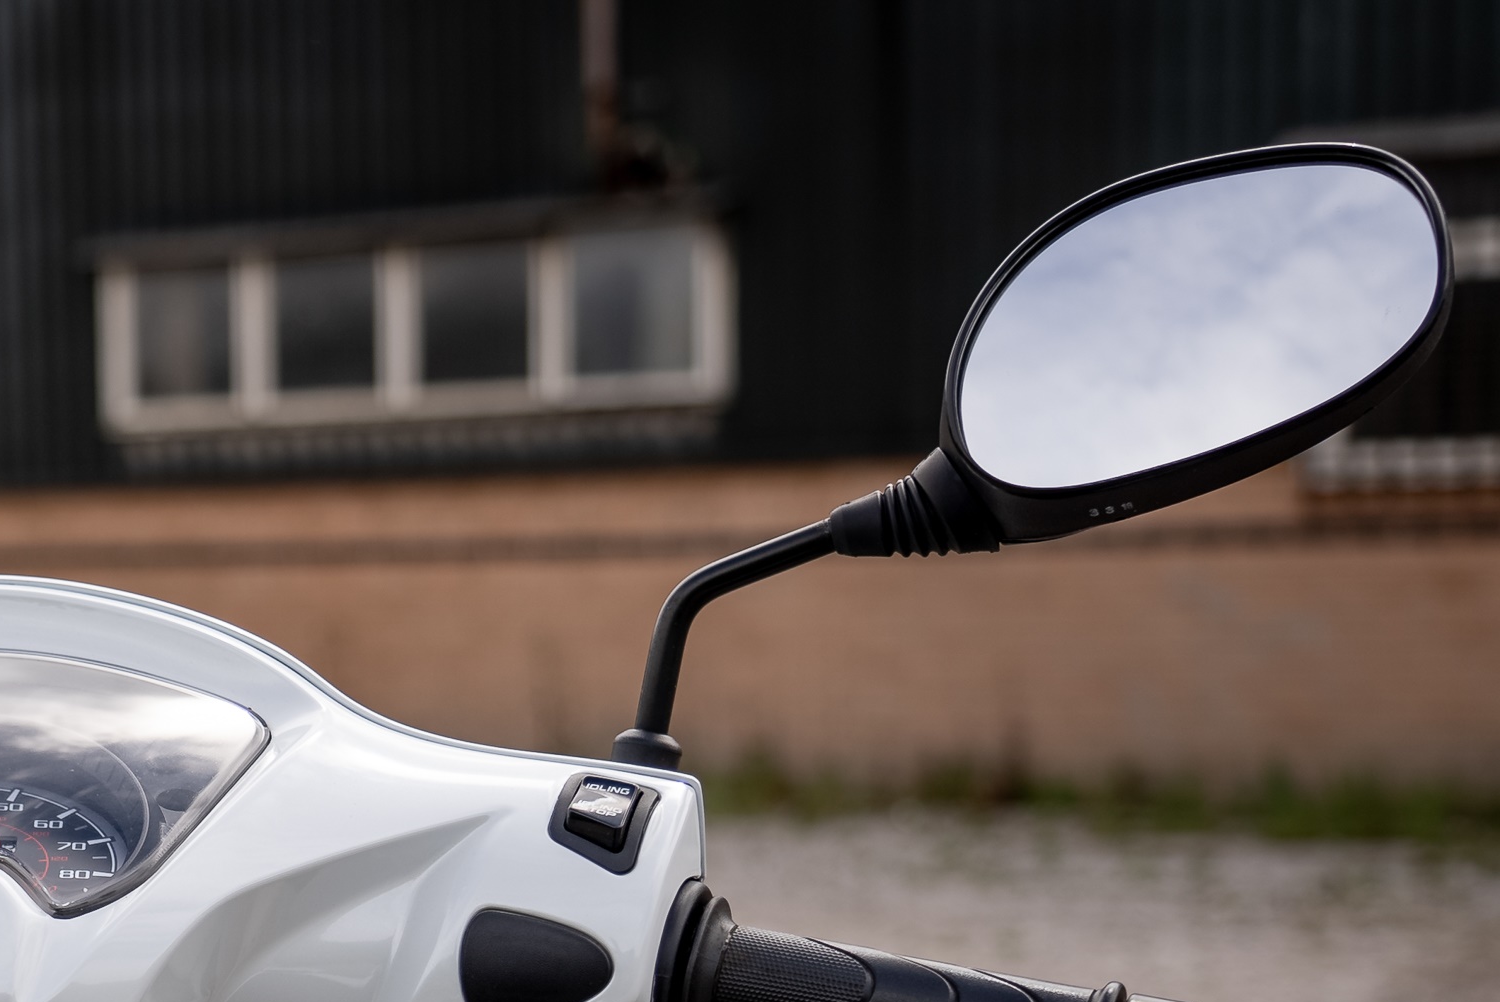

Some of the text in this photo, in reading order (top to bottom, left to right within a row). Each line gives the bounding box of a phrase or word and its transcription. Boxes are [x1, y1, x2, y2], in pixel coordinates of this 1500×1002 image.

[585, 783, 630, 795] IDLING
[578, 800, 623, 814] IING
[33, 820, 64, 829] 60
[57, 842, 87, 851] 70
[59, 869, 91, 880] 80
